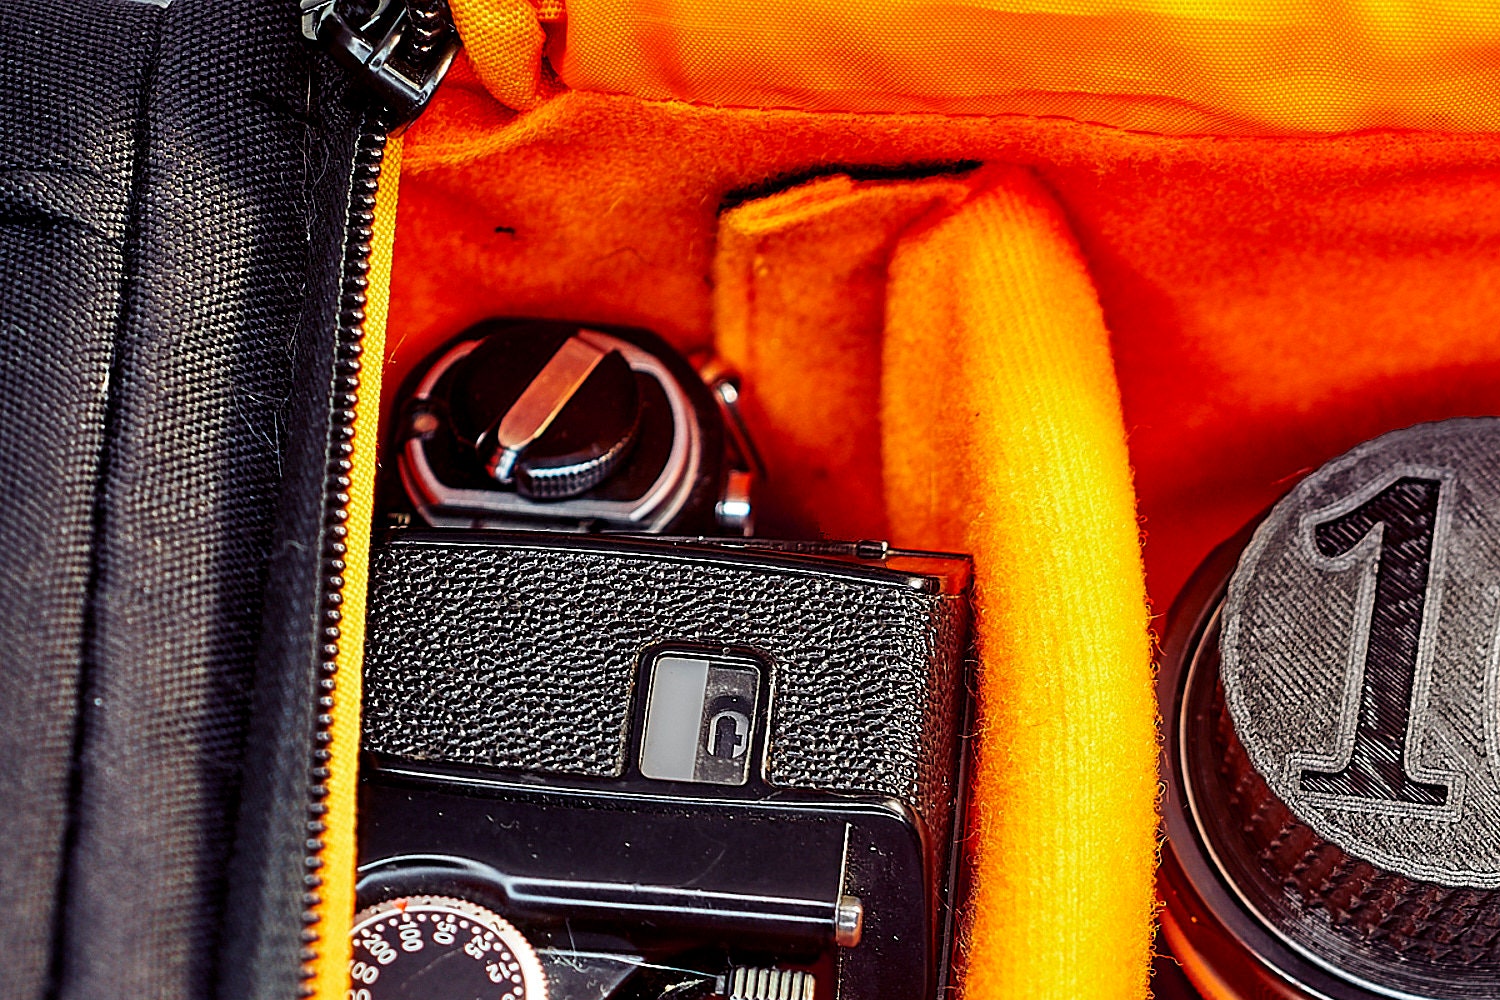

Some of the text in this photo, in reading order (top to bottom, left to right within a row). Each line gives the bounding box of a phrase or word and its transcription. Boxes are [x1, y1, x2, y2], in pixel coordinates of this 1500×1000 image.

[398, 920, 424, 952] 100
[433, 920, 458, 945] 50
[362, 933, 397, 965] 200
[464, 934, 491, 960] 25
[348, 960, 379, 984] 00
[485, 961, 511, 984] 12
